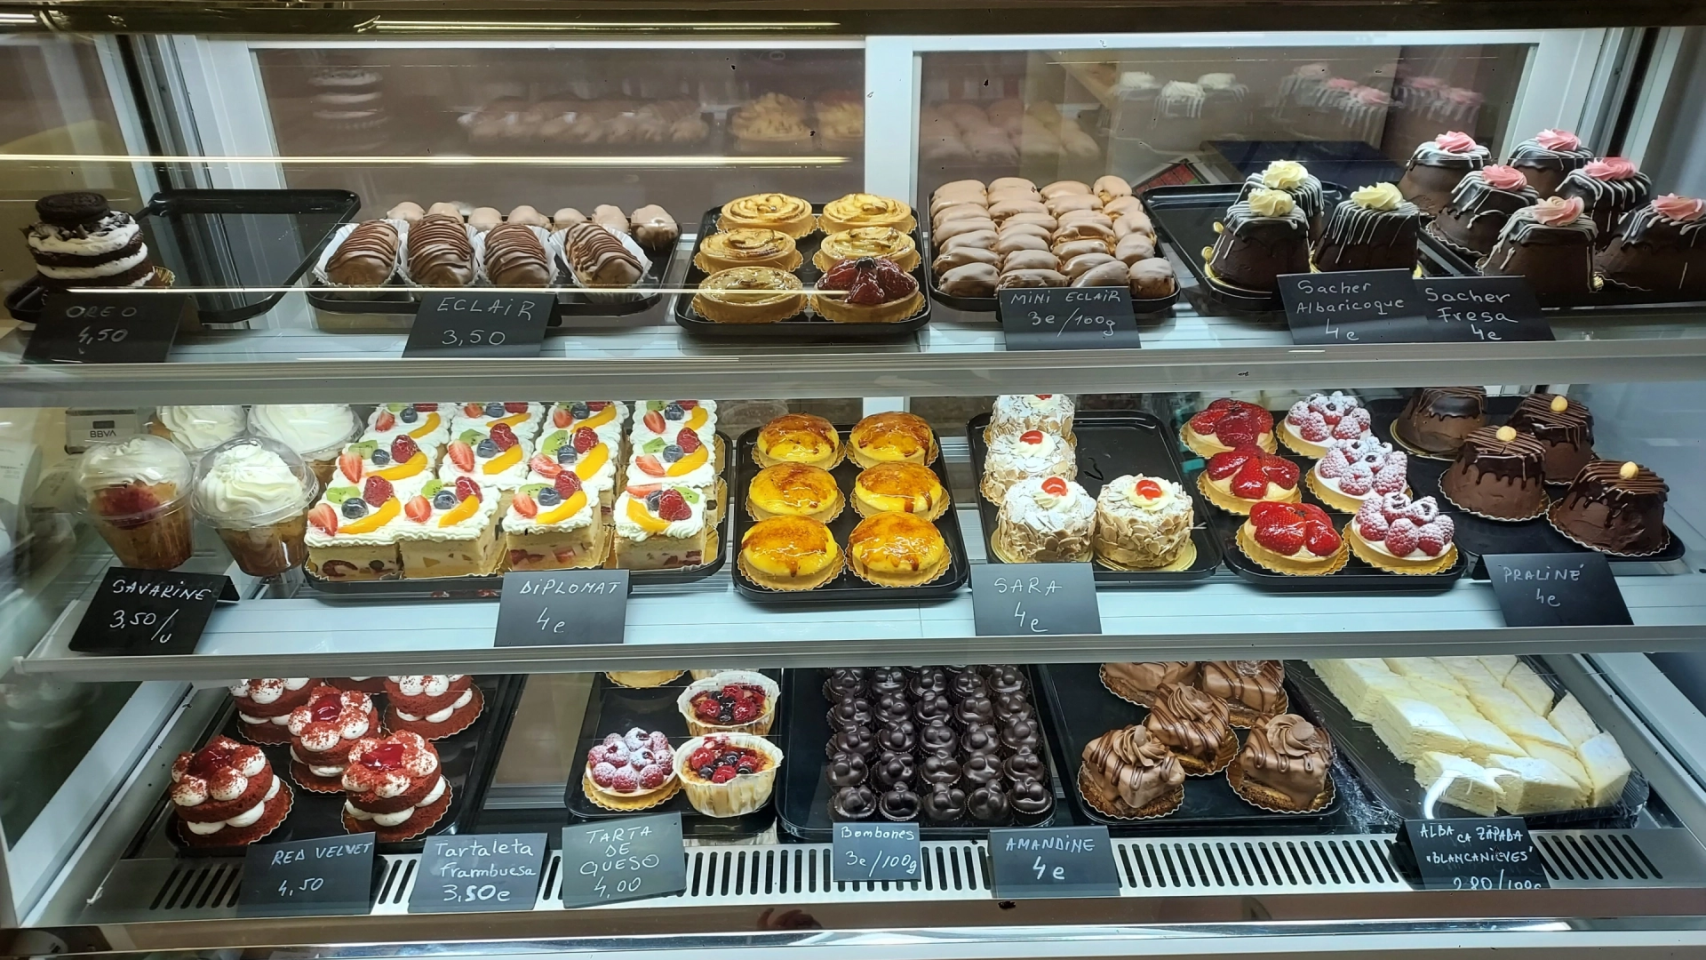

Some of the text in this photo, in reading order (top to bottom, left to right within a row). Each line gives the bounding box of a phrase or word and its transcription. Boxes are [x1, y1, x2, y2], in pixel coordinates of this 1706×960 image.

[1297, 280, 1371, 294] Sacher
[1425, 287, 1511, 303] Sacher
[66, 305, 137, 318] OREO
[1296, 299, 1404, 315] Albaricoque
[1437, 306, 1519, 323] Fresa
[78, 326, 128, 345] 4,50
[441, 329, 506, 346] 3,50
[90, 430, 117, 438] BBVA
[993, 576, 1063, 596] SARA
[586, 826, 652, 844] TARTA
[841, 826, 915, 840] Bombones
[1420, 823, 1455, 838] ALBA
[271, 842, 373, 866] RED VELVET
[435, 838, 534, 857] Tartaleta
[605, 842, 631, 857] DE
[580, 854, 659, 877] QUESO
[278, 877, 324, 897] 4,50
[442, 884, 511, 902] 3,50e
[594, 876, 641, 899] 4,00
